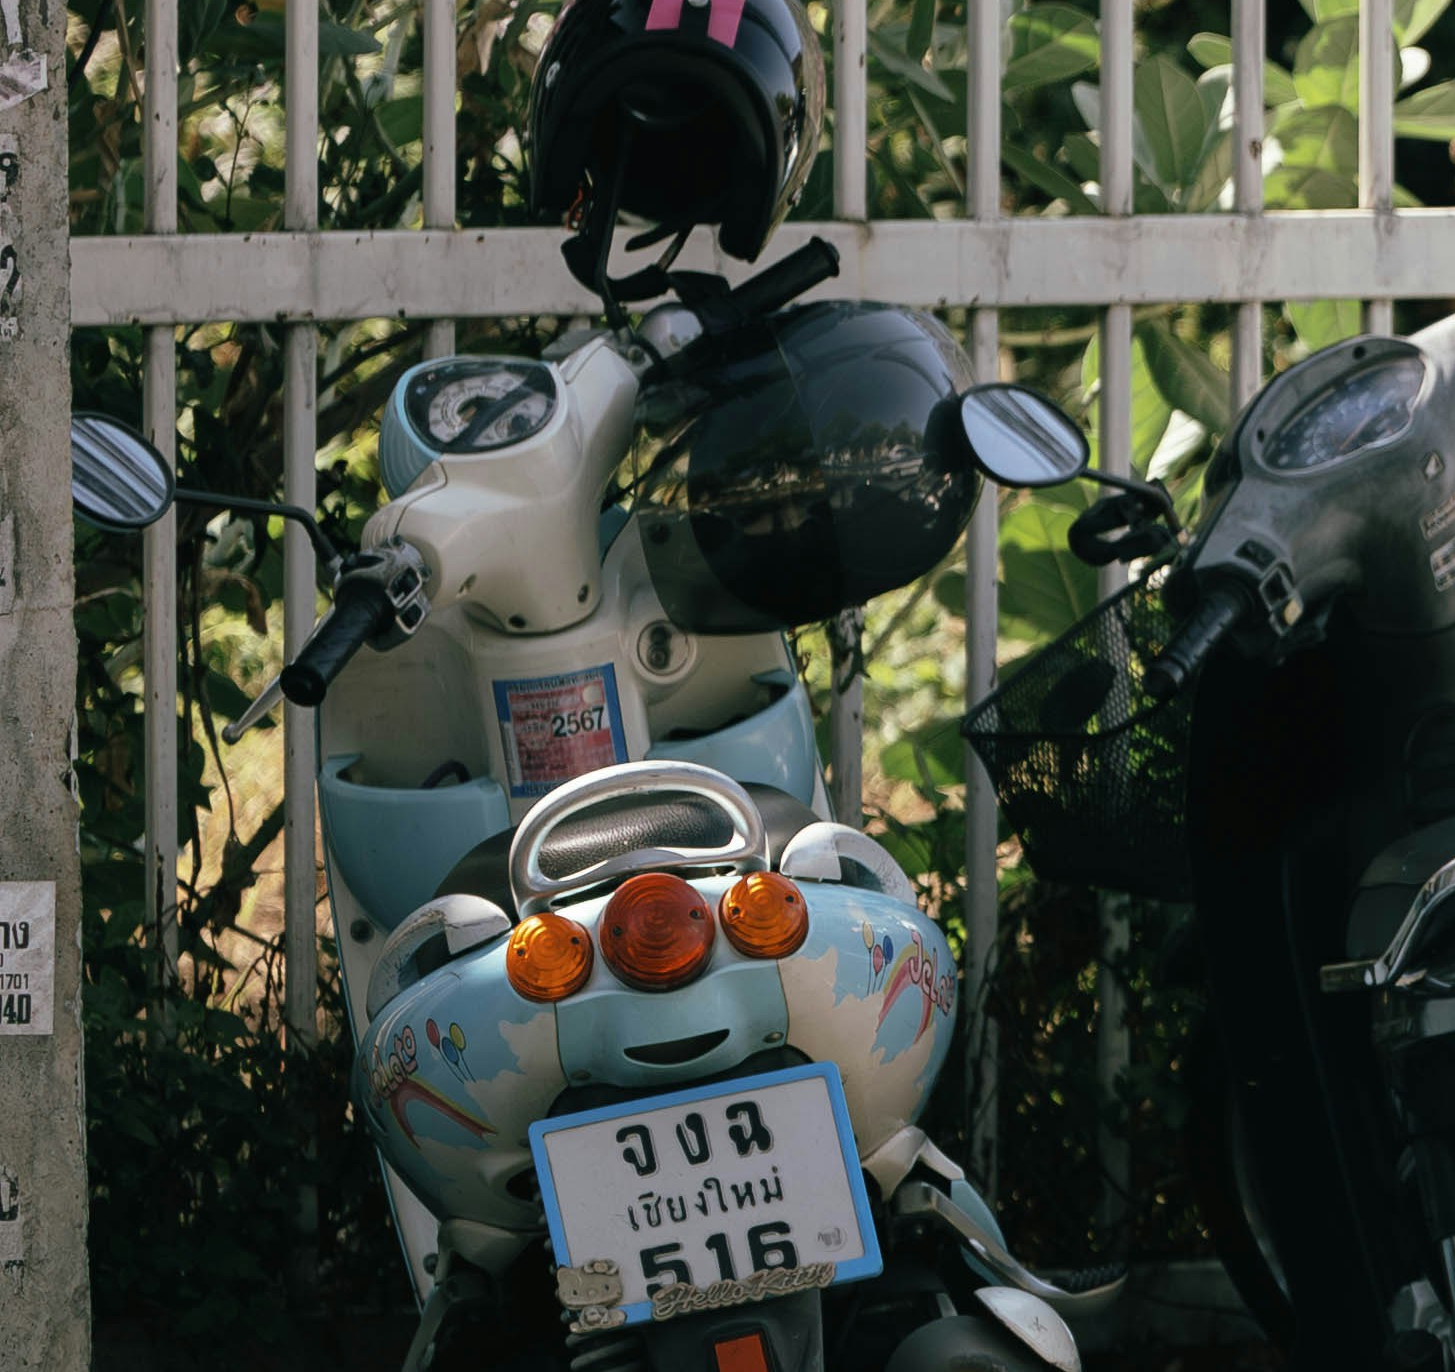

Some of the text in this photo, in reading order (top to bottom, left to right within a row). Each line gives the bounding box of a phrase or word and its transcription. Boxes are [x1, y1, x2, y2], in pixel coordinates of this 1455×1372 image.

[551, 706, 605, 738] 2567
[616, 1101, 774, 1177] จงฉ
[627, 1165, 784, 1232] เชียงใหม่
[639, 1220, 799, 1300] 516
[652, 1261, 837, 1322] Hello Kitty
